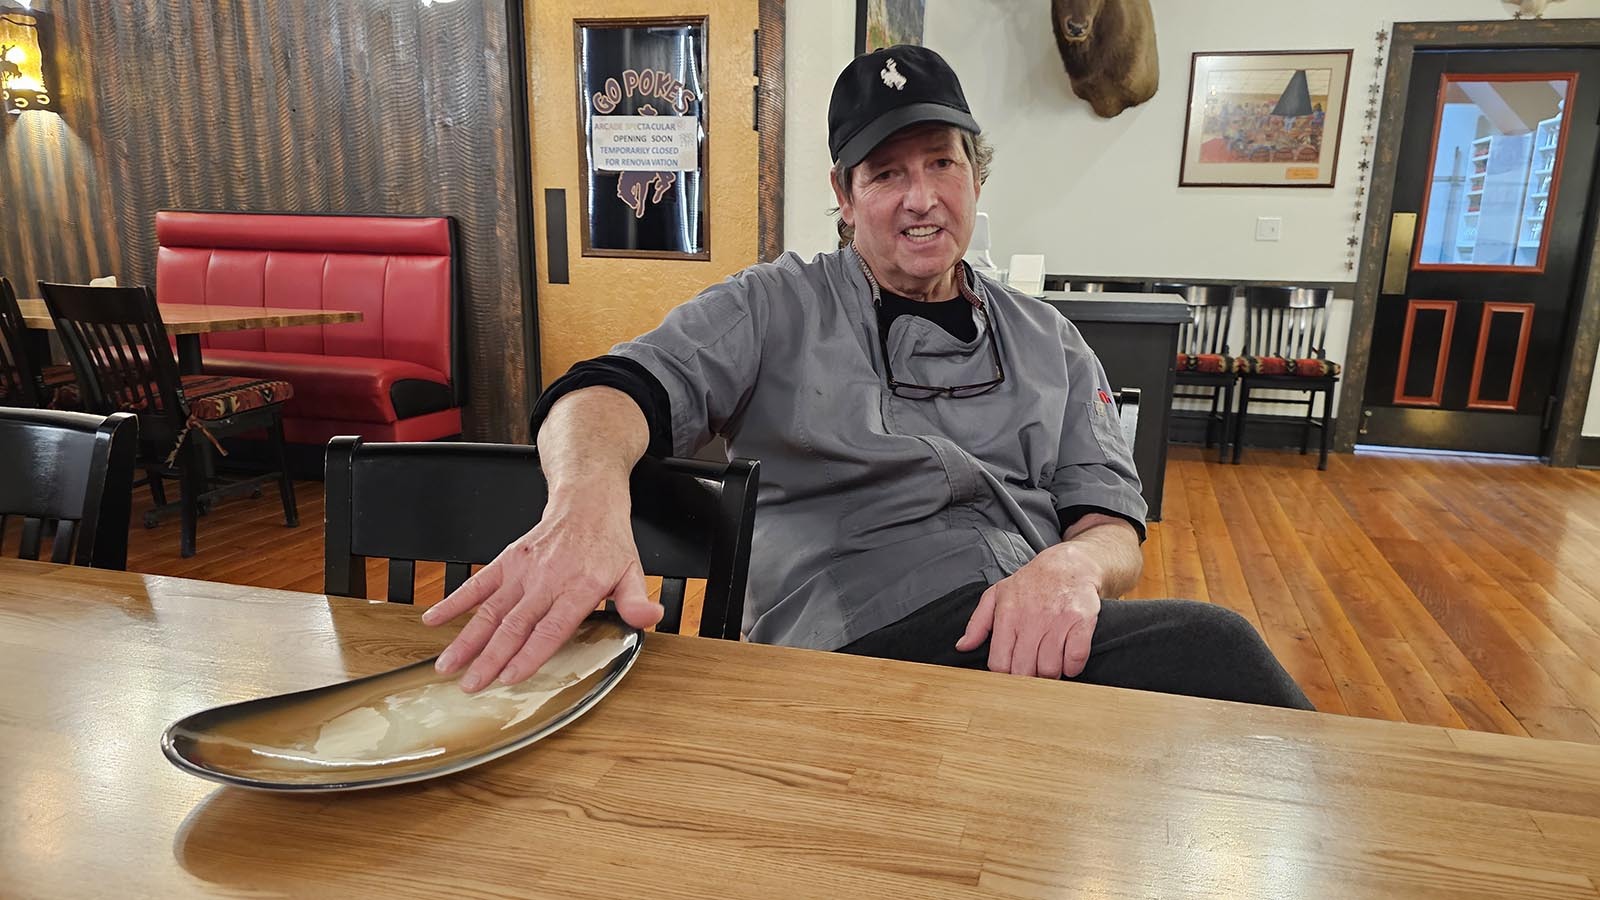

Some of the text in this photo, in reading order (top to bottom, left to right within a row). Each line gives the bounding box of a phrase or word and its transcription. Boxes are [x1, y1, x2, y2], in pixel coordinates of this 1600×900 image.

[593, 69, 695, 114] GO POKES
[613, 134, 673, 143] OPENING SOON
[600, 146, 679, 155] TEMPORARILY CLOSED
[605, 158, 620, 167] FOR
